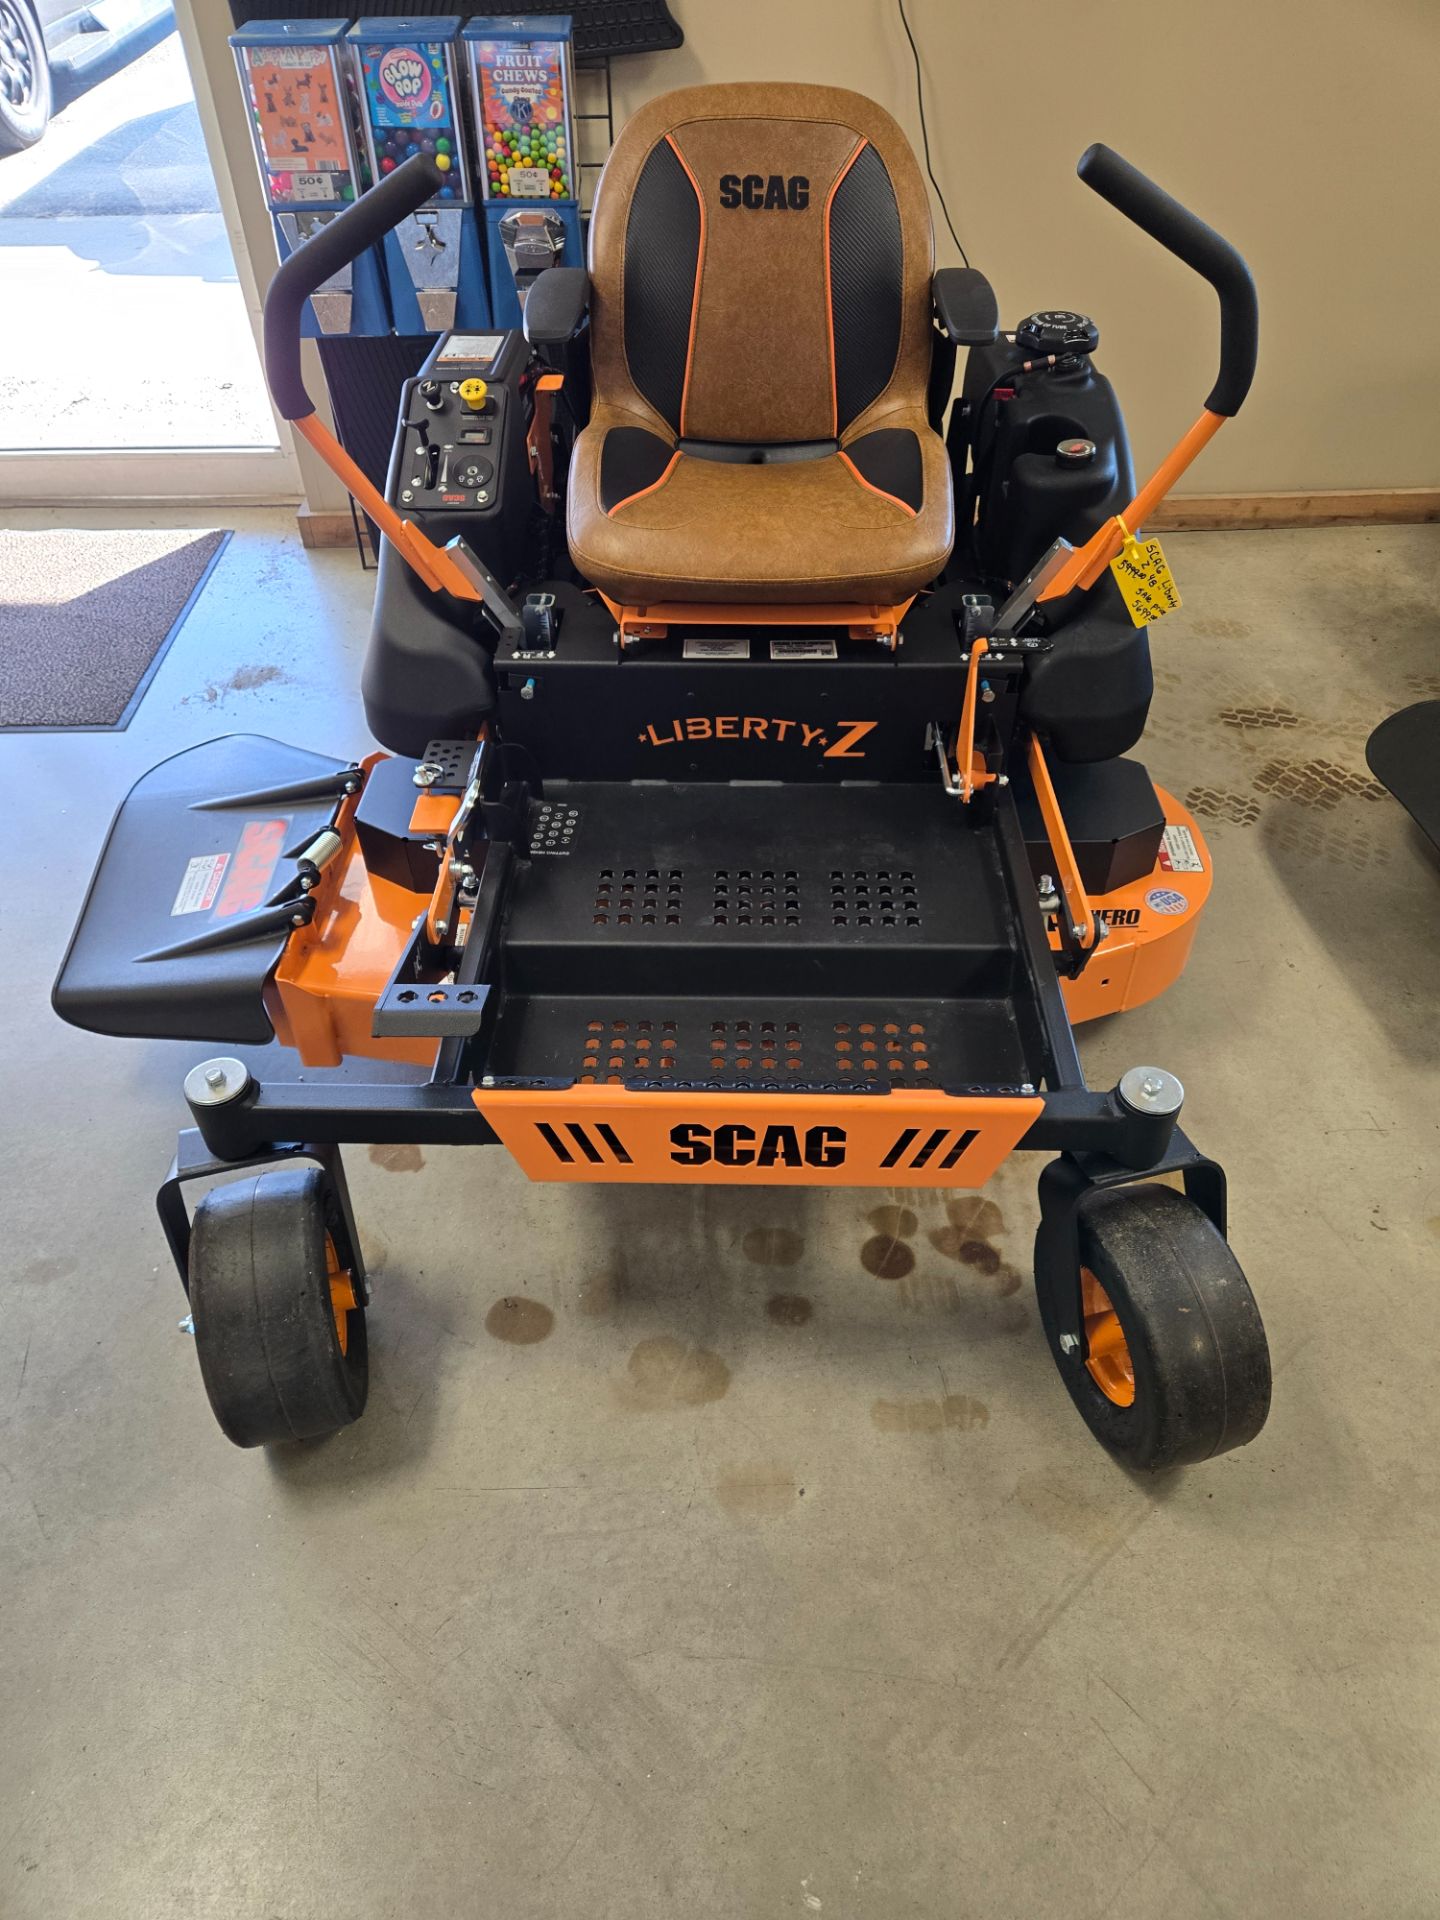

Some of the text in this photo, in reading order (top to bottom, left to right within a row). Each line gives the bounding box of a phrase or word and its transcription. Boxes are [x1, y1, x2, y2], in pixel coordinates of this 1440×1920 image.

[495, 55, 542, 67] FRUIT
[383, 60, 423, 85] BLOW
[492, 69, 548, 82] CHEWS
[395, 78, 421, 97] POP
[719, 174, 810, 211] SCAG
[646, 716, 878, 757] LIBERTY Z
[1160, 892, 1184, 906] USA
[669, 1123, 847, 1168] SCAG
